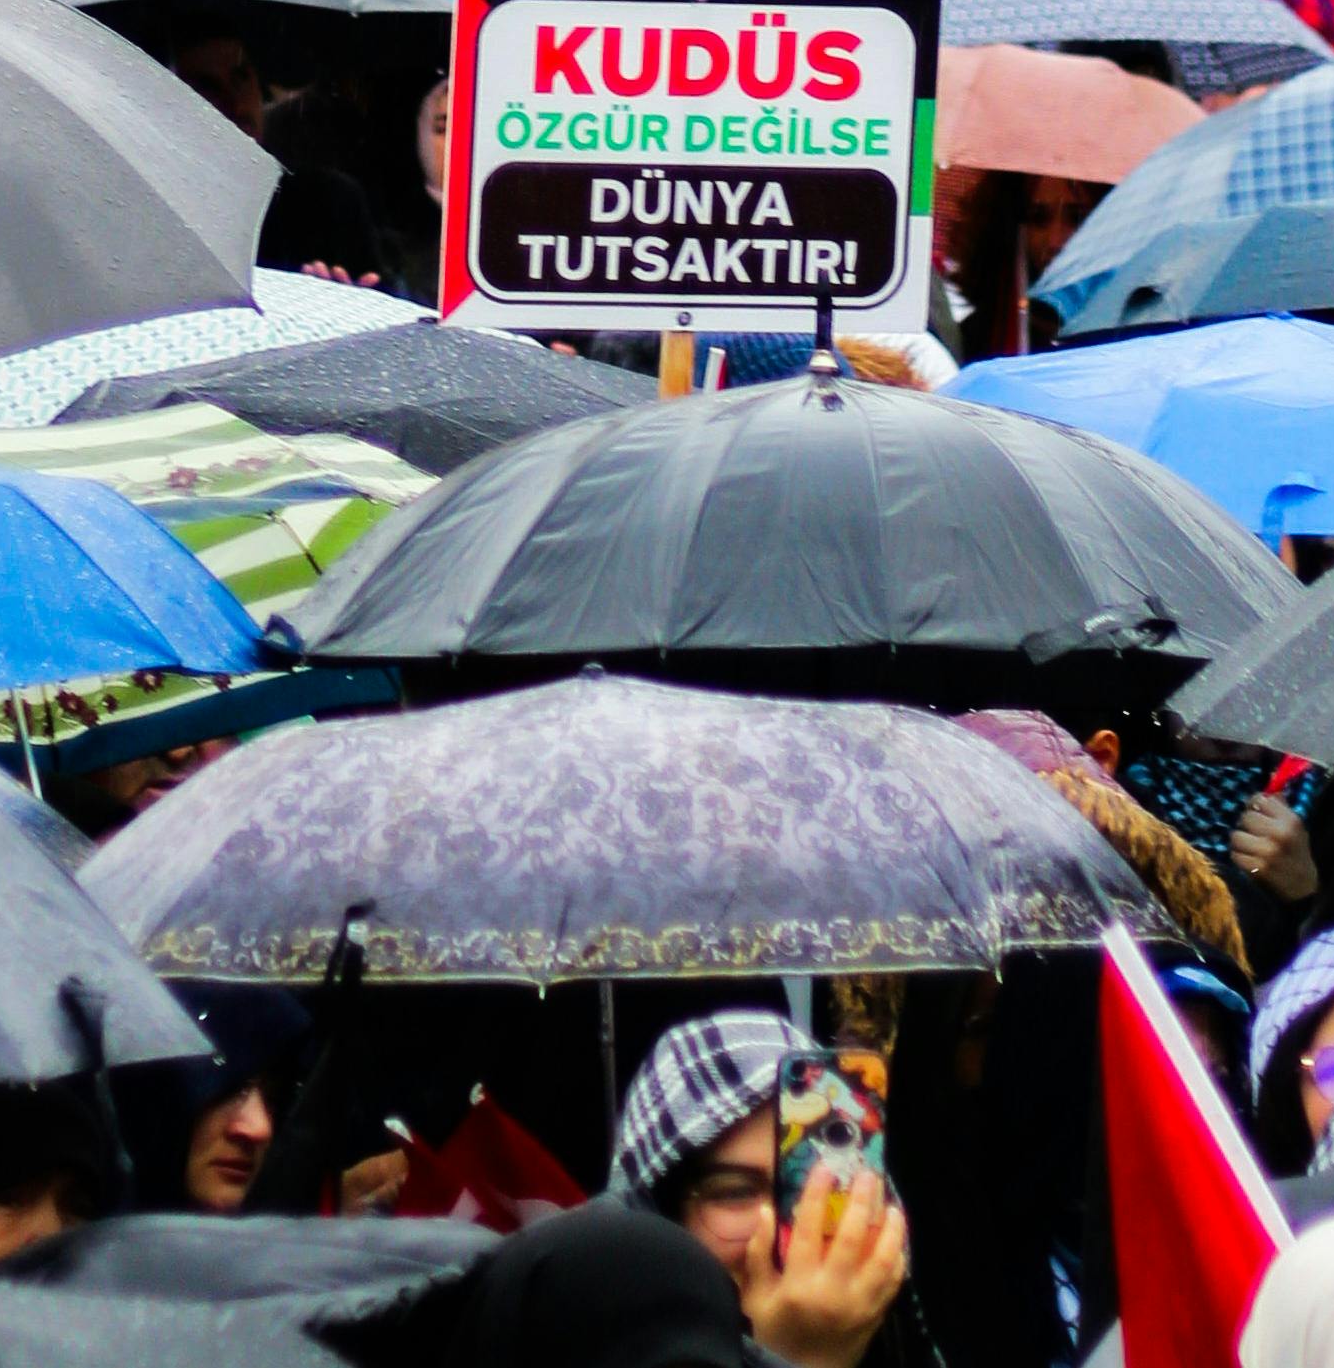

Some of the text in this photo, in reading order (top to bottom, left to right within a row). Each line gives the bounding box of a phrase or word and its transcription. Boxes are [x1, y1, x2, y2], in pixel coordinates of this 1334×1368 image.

[534, 12, 863, 102] KUDÜS
[496, 102, 892, 156] ÖZGÜR DEĞİLSE
[590, 169, 793, 226] DÜNYA
[519, 234, 858, 285] TUTSAKTIR!
